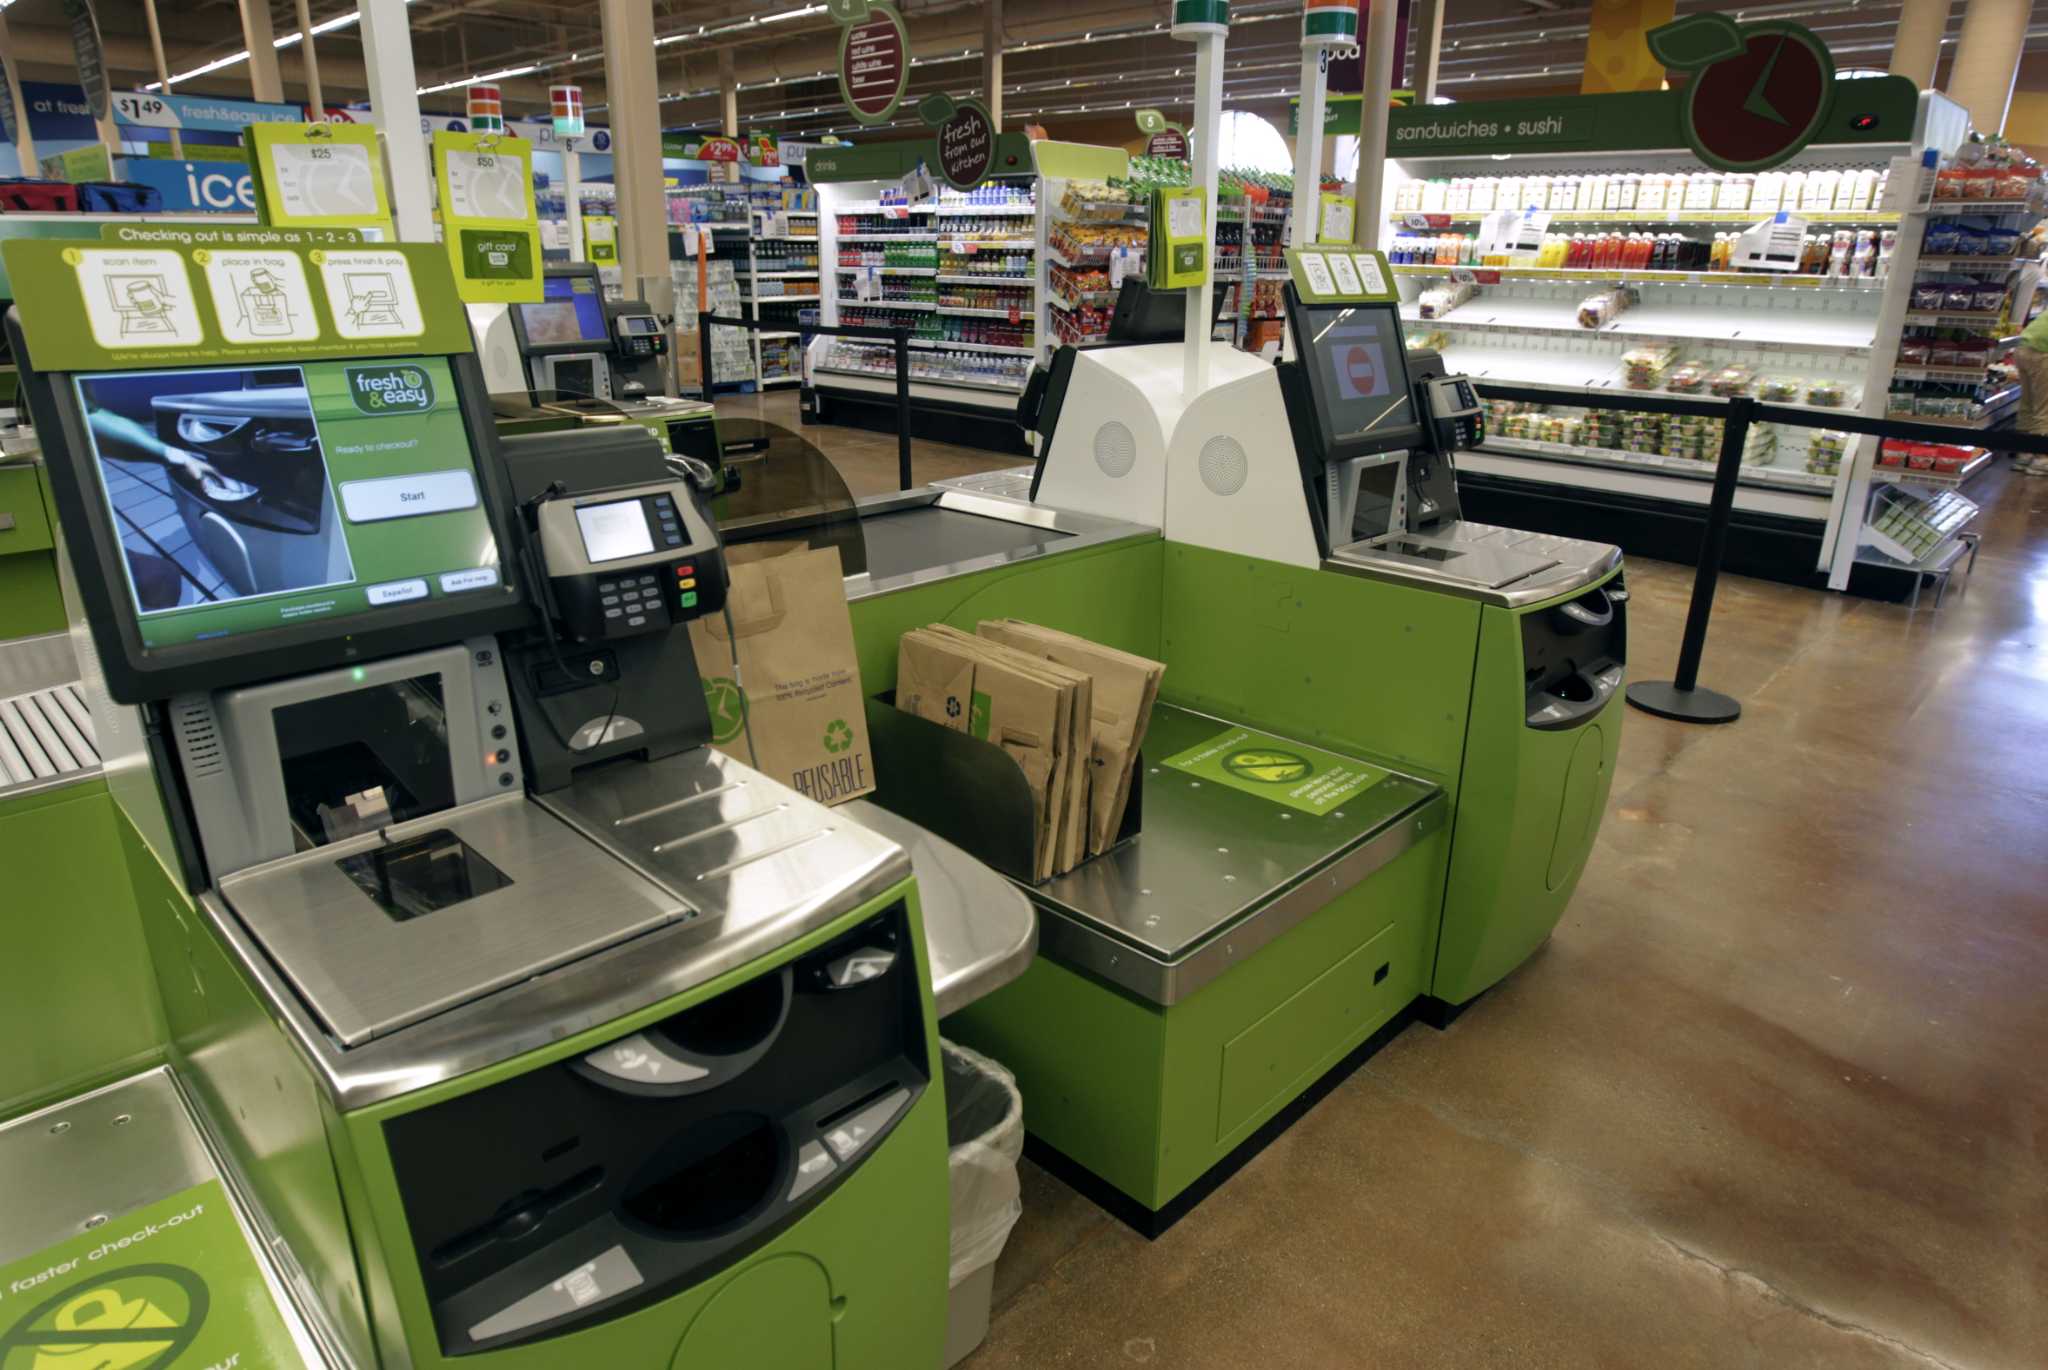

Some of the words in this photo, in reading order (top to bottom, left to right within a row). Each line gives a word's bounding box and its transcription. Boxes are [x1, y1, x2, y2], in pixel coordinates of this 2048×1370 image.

[1320, 49, 1327, 73] 3
[944, 115, 981, 144] fresh
[1396, 120, 1499, 141] sandwiches
[1517, 116, 1563, 136] sushi
[311, 148, 332, 160] $25
[944, 144, 968, 160] from
[970, 133, 987, 149] our
[477, 157, 495, 168] $50
[185, 163, 256, 209] ice
[119, 227, 191, 244] Checking
[195, 230, 218, 242] out
[223, 230, 234, 242] is
[236, 230, 281, 244] simple
[284, 233, 300, 242] as
[478, 242, 493, 253] gift
[495, 242, 517, 252] card
[103, 258, 129, 266] scan
[222, 258, 250, 267] place
[253, 257, 261, 265] in
[263, 258, 285, 267] bag
[356, 372, 404, 392] fresh
[369, 391, 387, 408] &
[383, 388, 427, 407] easy
[335, 445, 363, 455] Ready
[365, 443, 374, 452] to
[376, 439, 419, 451] checkout?
[400, 490, 425, 503] Start
[792, 753, 867, 803] REUSABLE
[10, 1257, 80, 1294] faster
[87, 1203, 204, 1262] check-out
